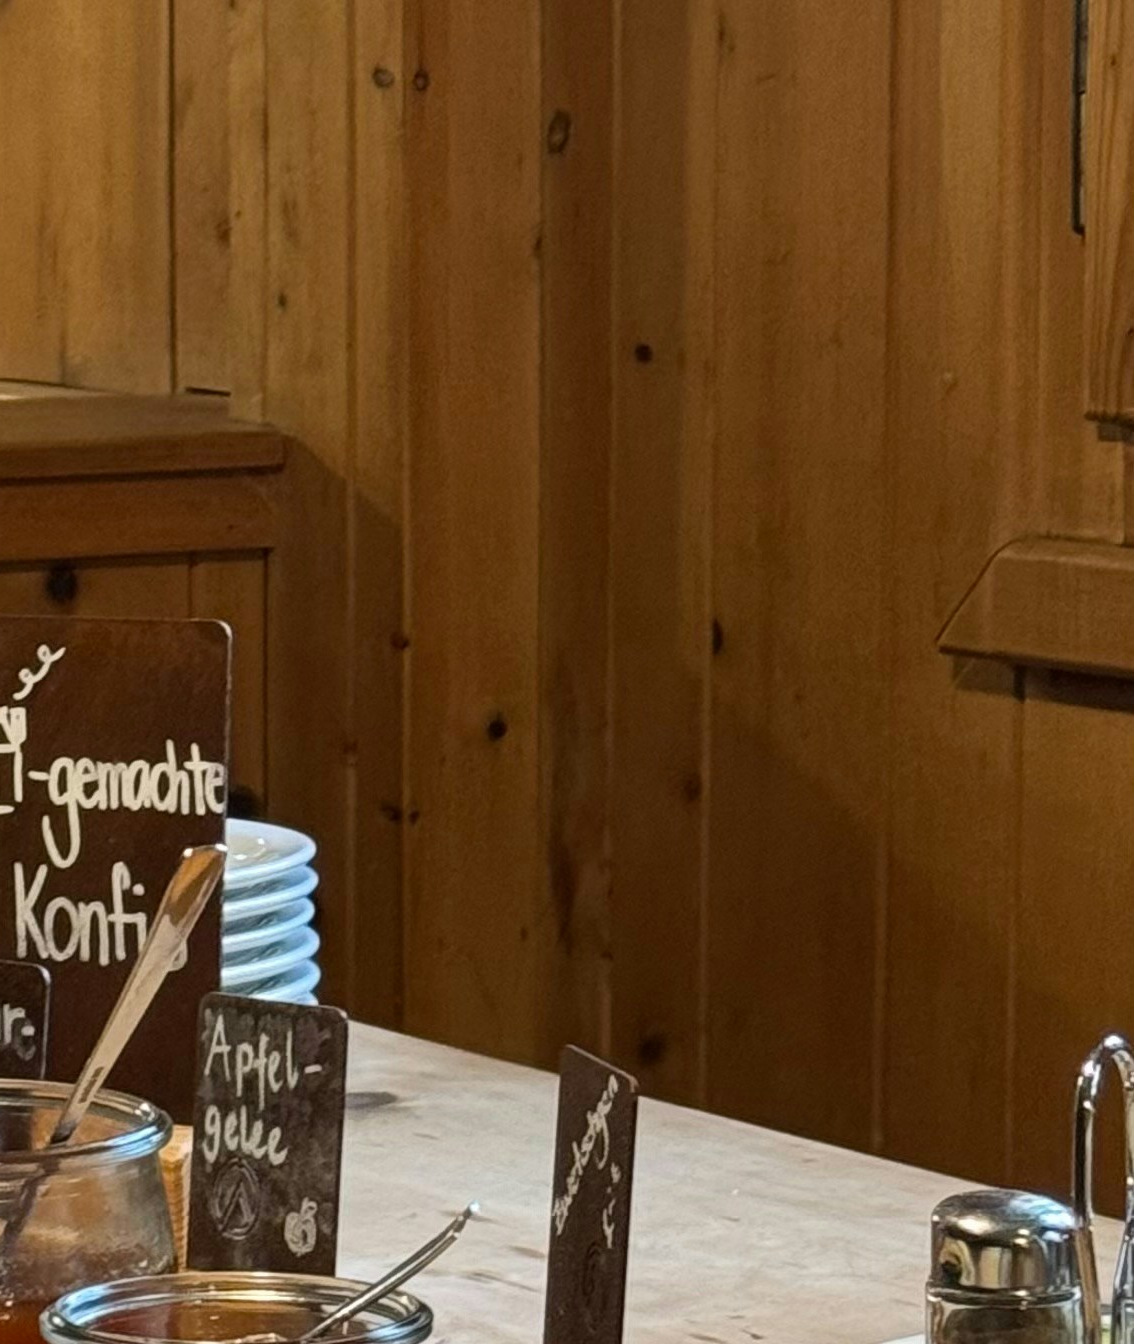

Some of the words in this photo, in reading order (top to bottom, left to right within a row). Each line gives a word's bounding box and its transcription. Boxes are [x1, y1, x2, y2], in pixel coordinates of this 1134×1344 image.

[14, 861, 187, 972] Konfi
[204, 1014, 322, 1110] Apfel-
[203, 1105, 288, 1165] gelee
